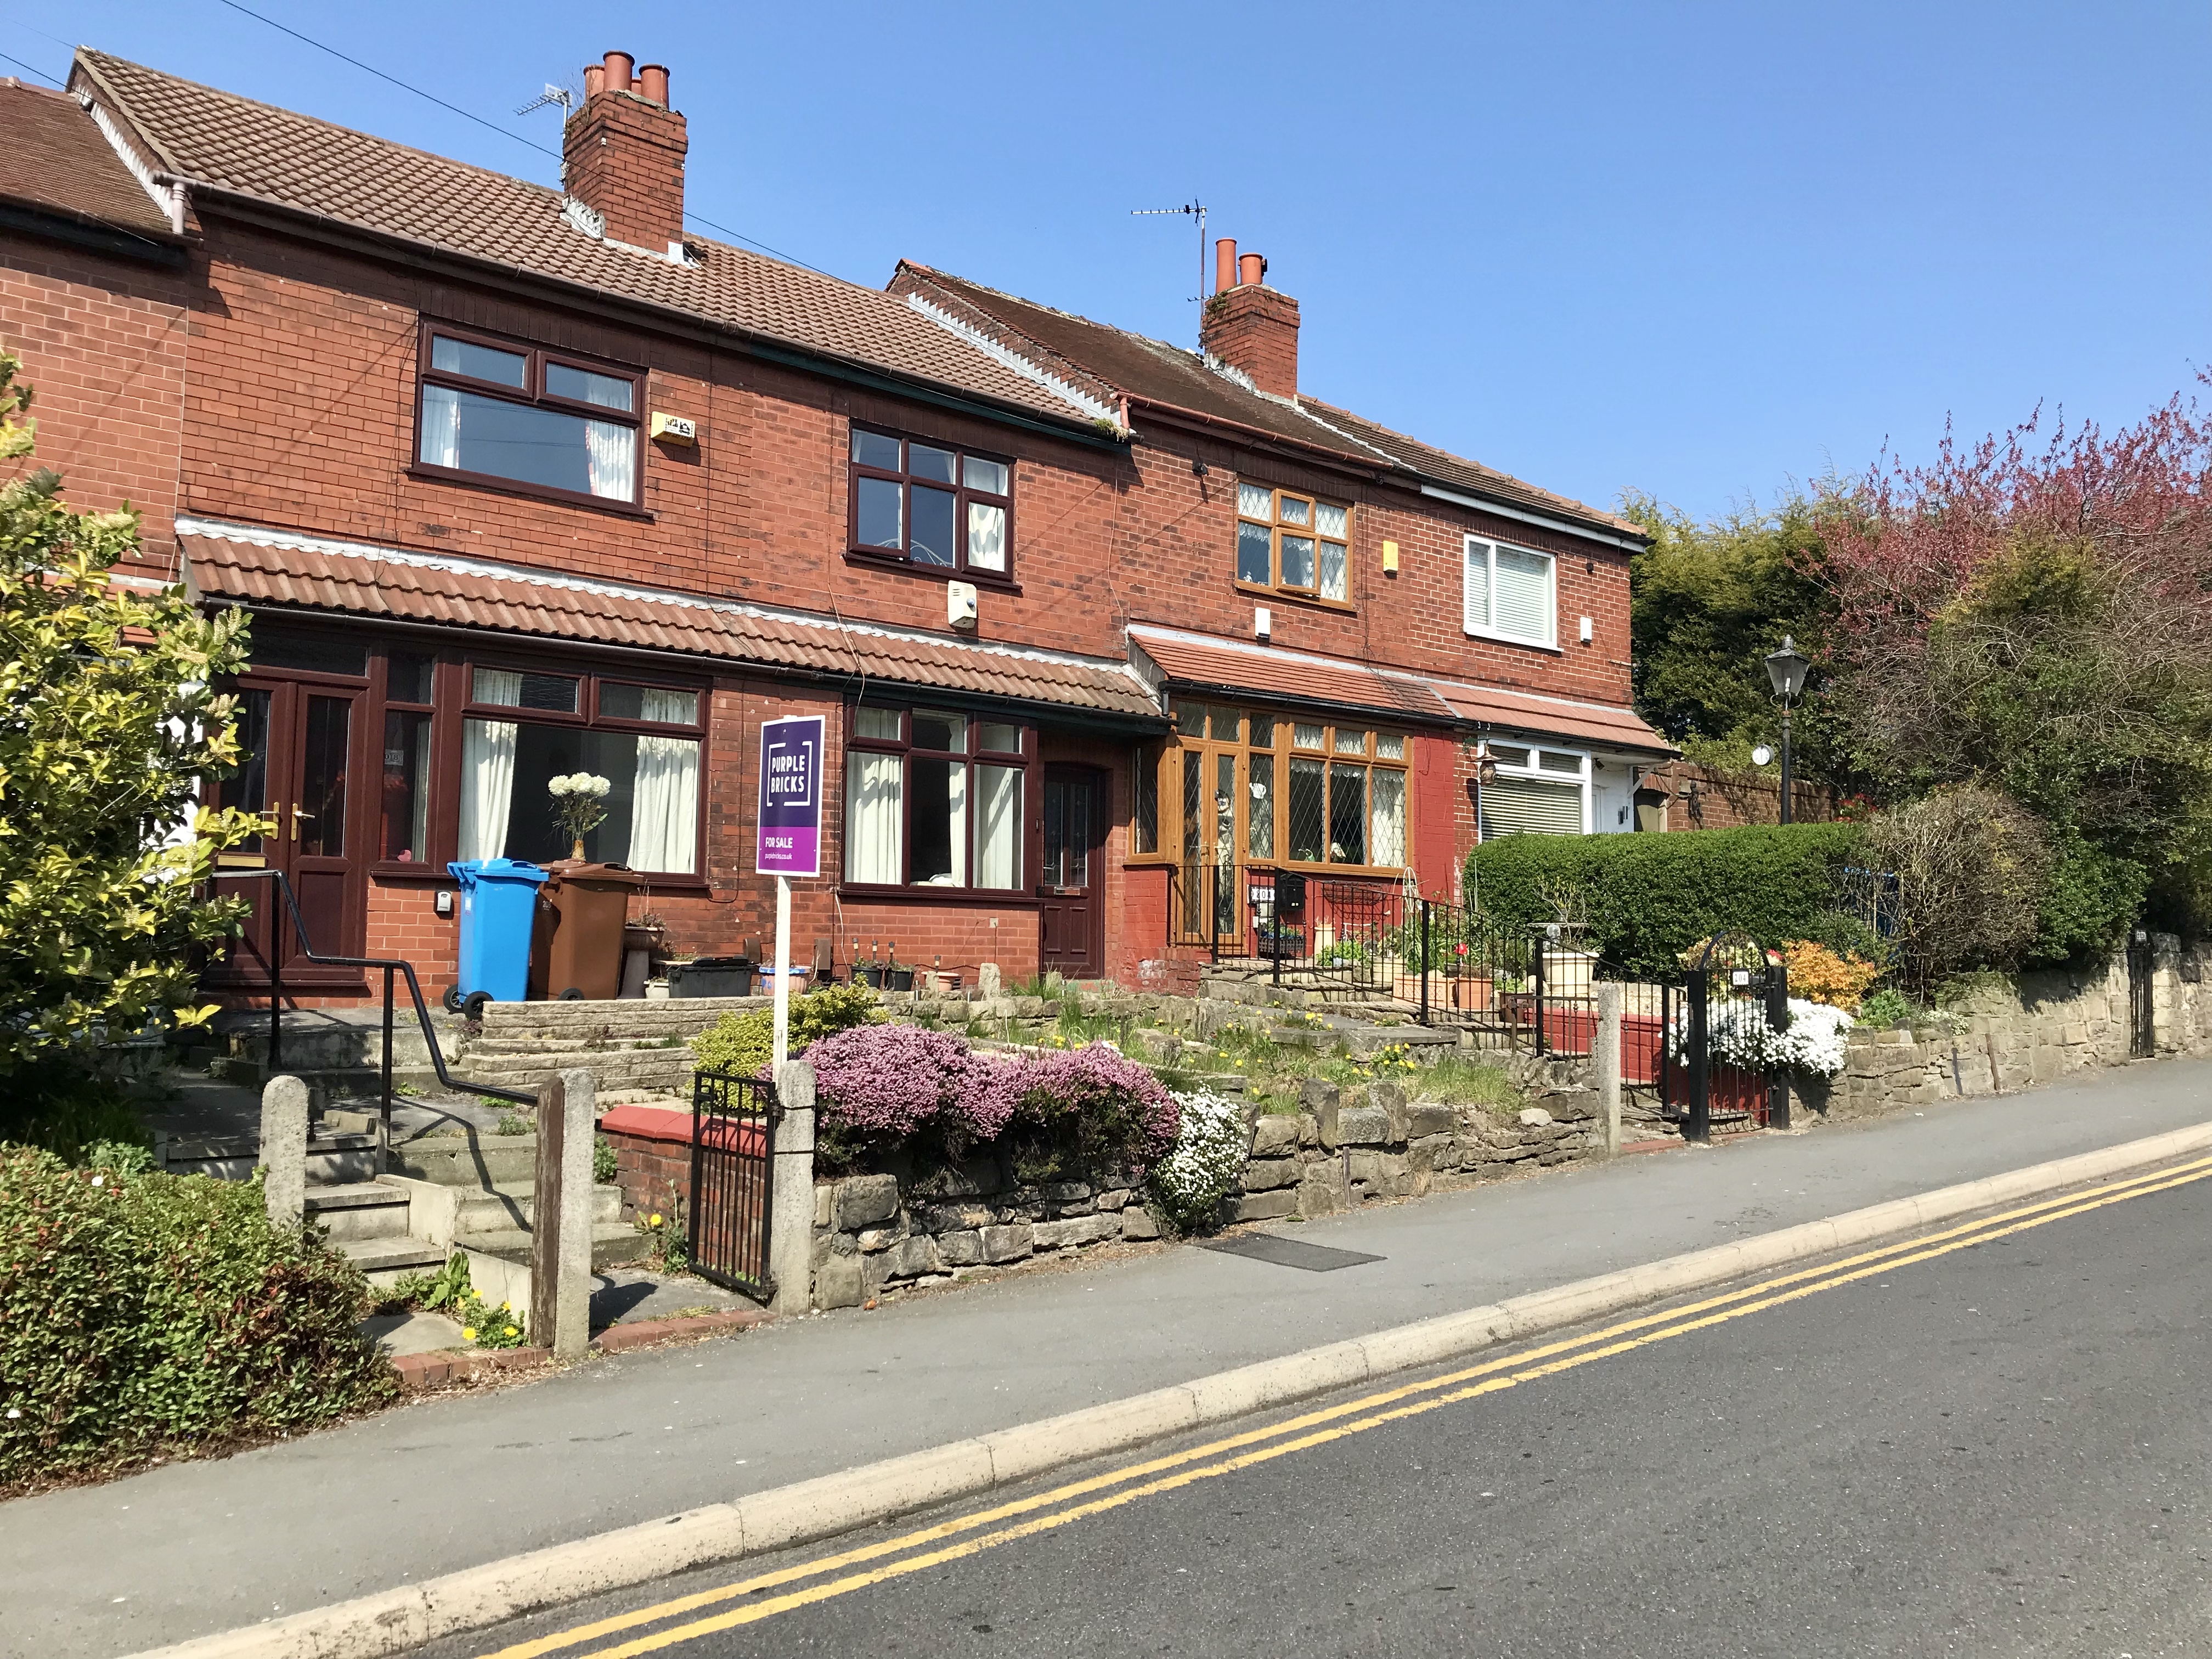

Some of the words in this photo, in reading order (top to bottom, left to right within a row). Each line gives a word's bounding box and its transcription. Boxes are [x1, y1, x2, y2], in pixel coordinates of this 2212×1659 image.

[771, 755, 805, 773] PURPLE
[771, 775, 804, 793] BRICKS
[765, 837, 775, 848] FOR
[776, 837, 793, 848] SALE
[1735, 973, 1746, 983] 204
